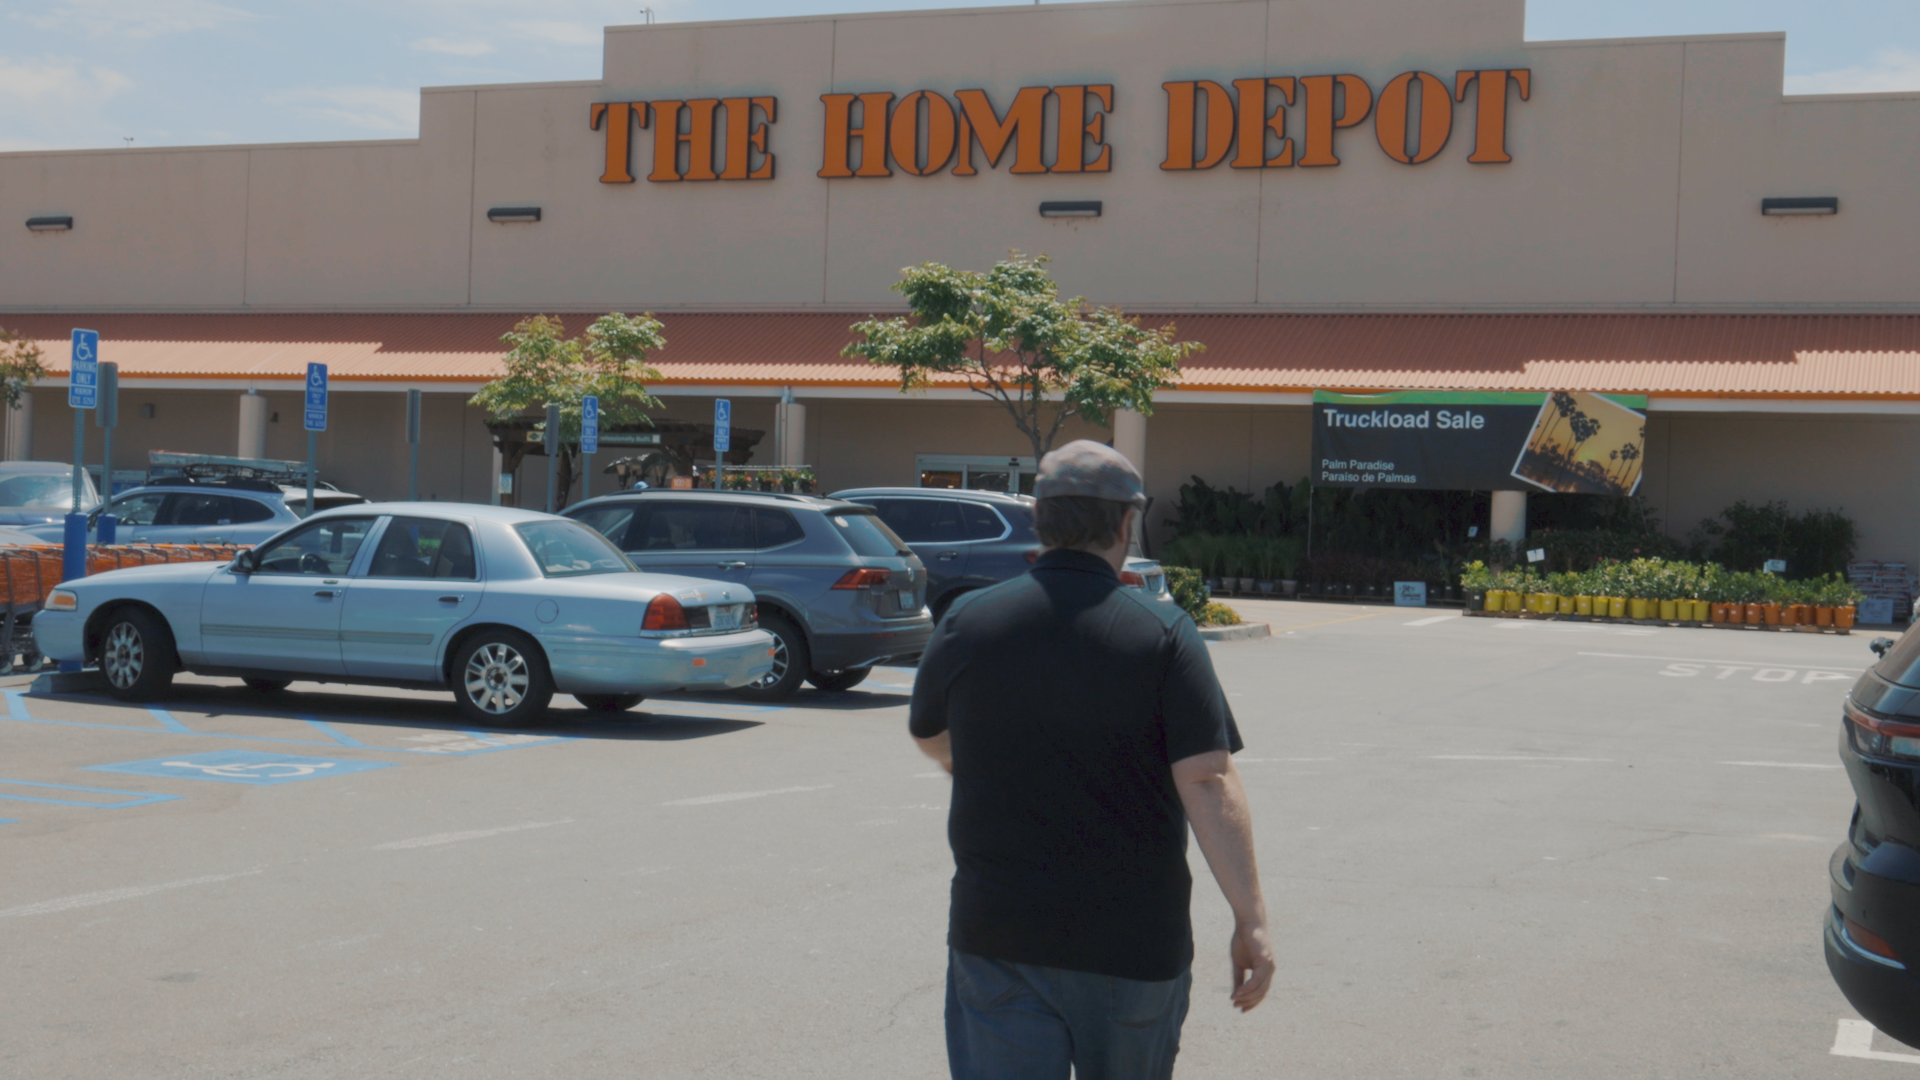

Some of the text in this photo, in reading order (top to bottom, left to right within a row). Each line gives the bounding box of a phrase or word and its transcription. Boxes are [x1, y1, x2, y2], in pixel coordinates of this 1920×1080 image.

[589, 68, 1532, 184] THE HOME DEPOT
[73, 360, 97, 373] PARKING
[76, 372, 92, 385] ONLY
[1323, 409, 1485, 430] Truckload Sale
[1322, 459, 1395, 471] Palm Paradise
[1322, 471, 1417, 484] Paraíso de Palmas
[1658, 663, 1852, 684] STOP
